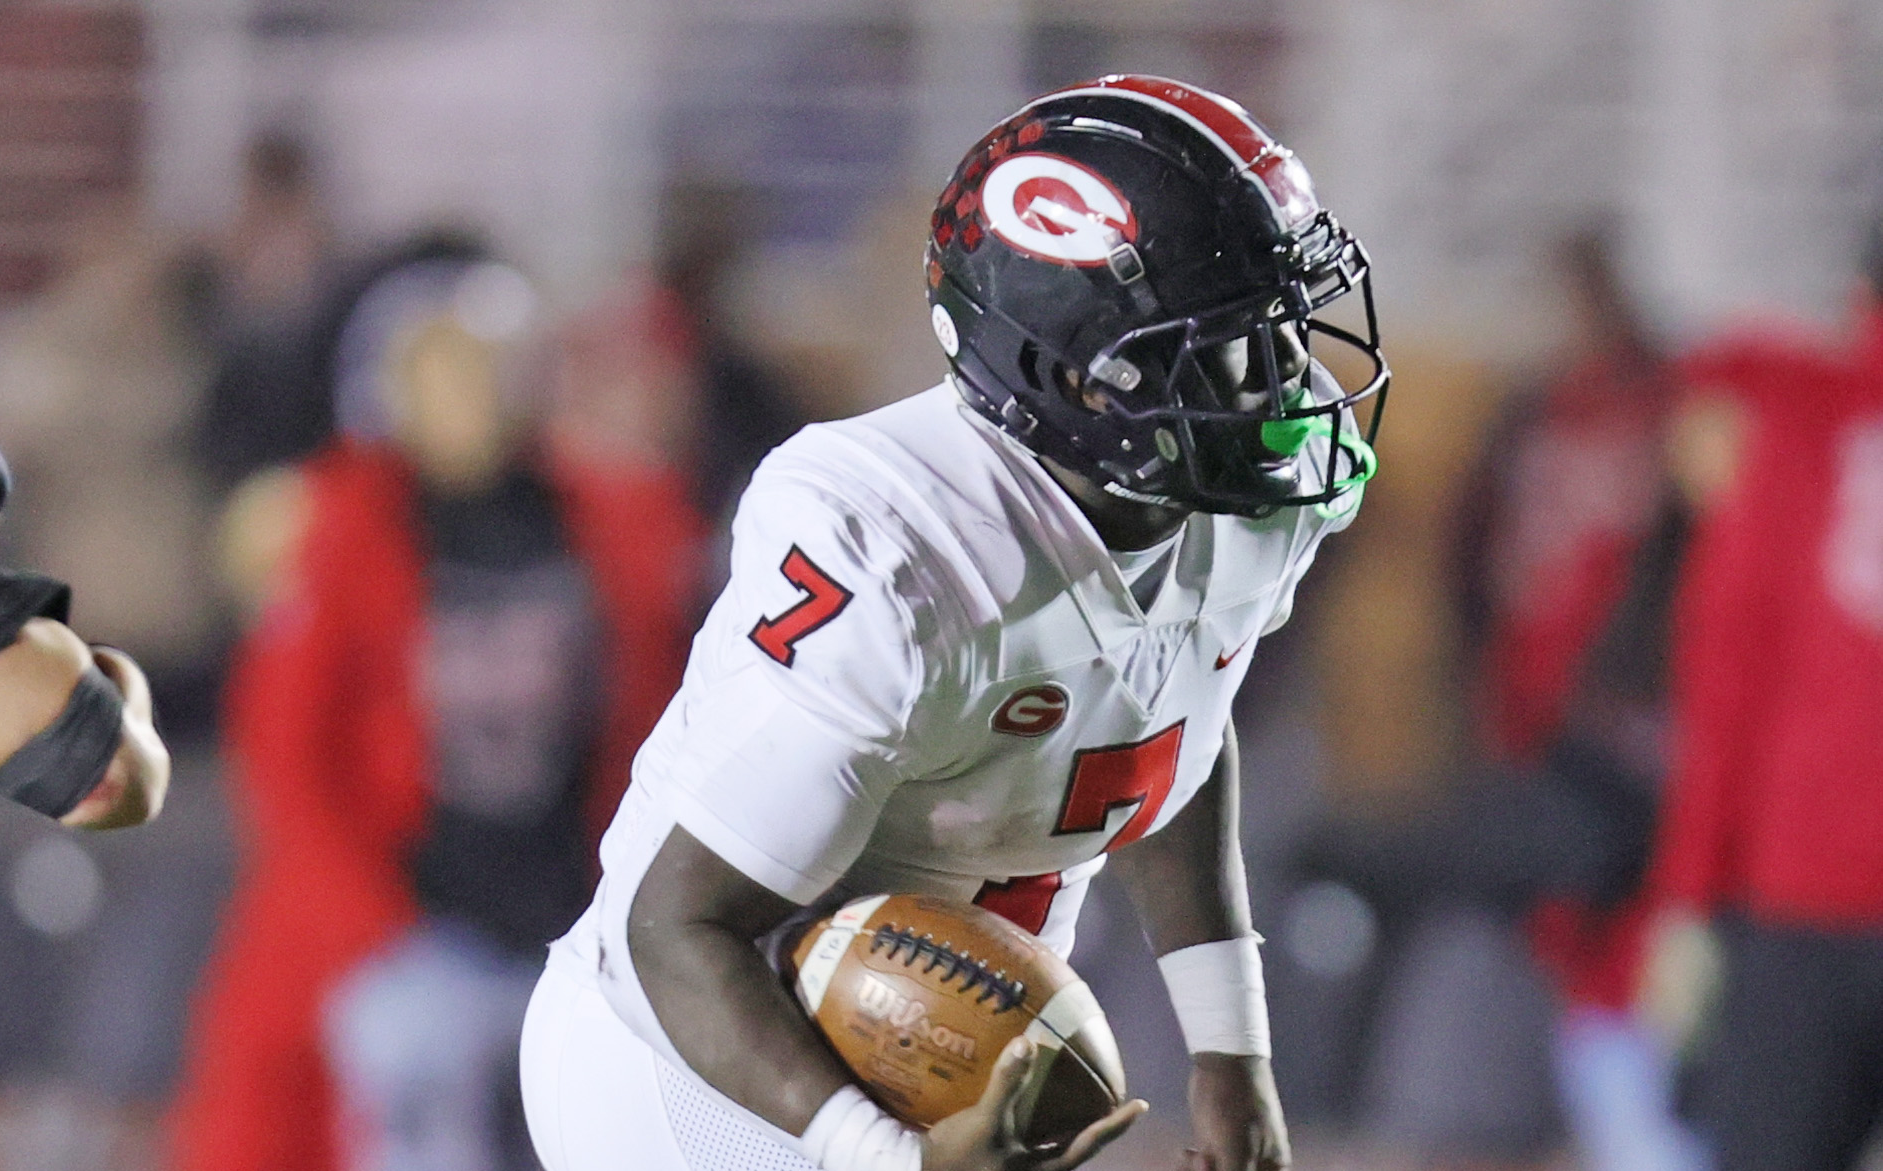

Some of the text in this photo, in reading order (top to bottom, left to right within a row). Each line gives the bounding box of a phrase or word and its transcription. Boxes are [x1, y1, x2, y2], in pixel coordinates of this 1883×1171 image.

[978, 152, 1137, 267] G
[749, 543, 854, 669] 7
[989, 683, 1071, 738] G
[970, 716, 1187, 936] 7
